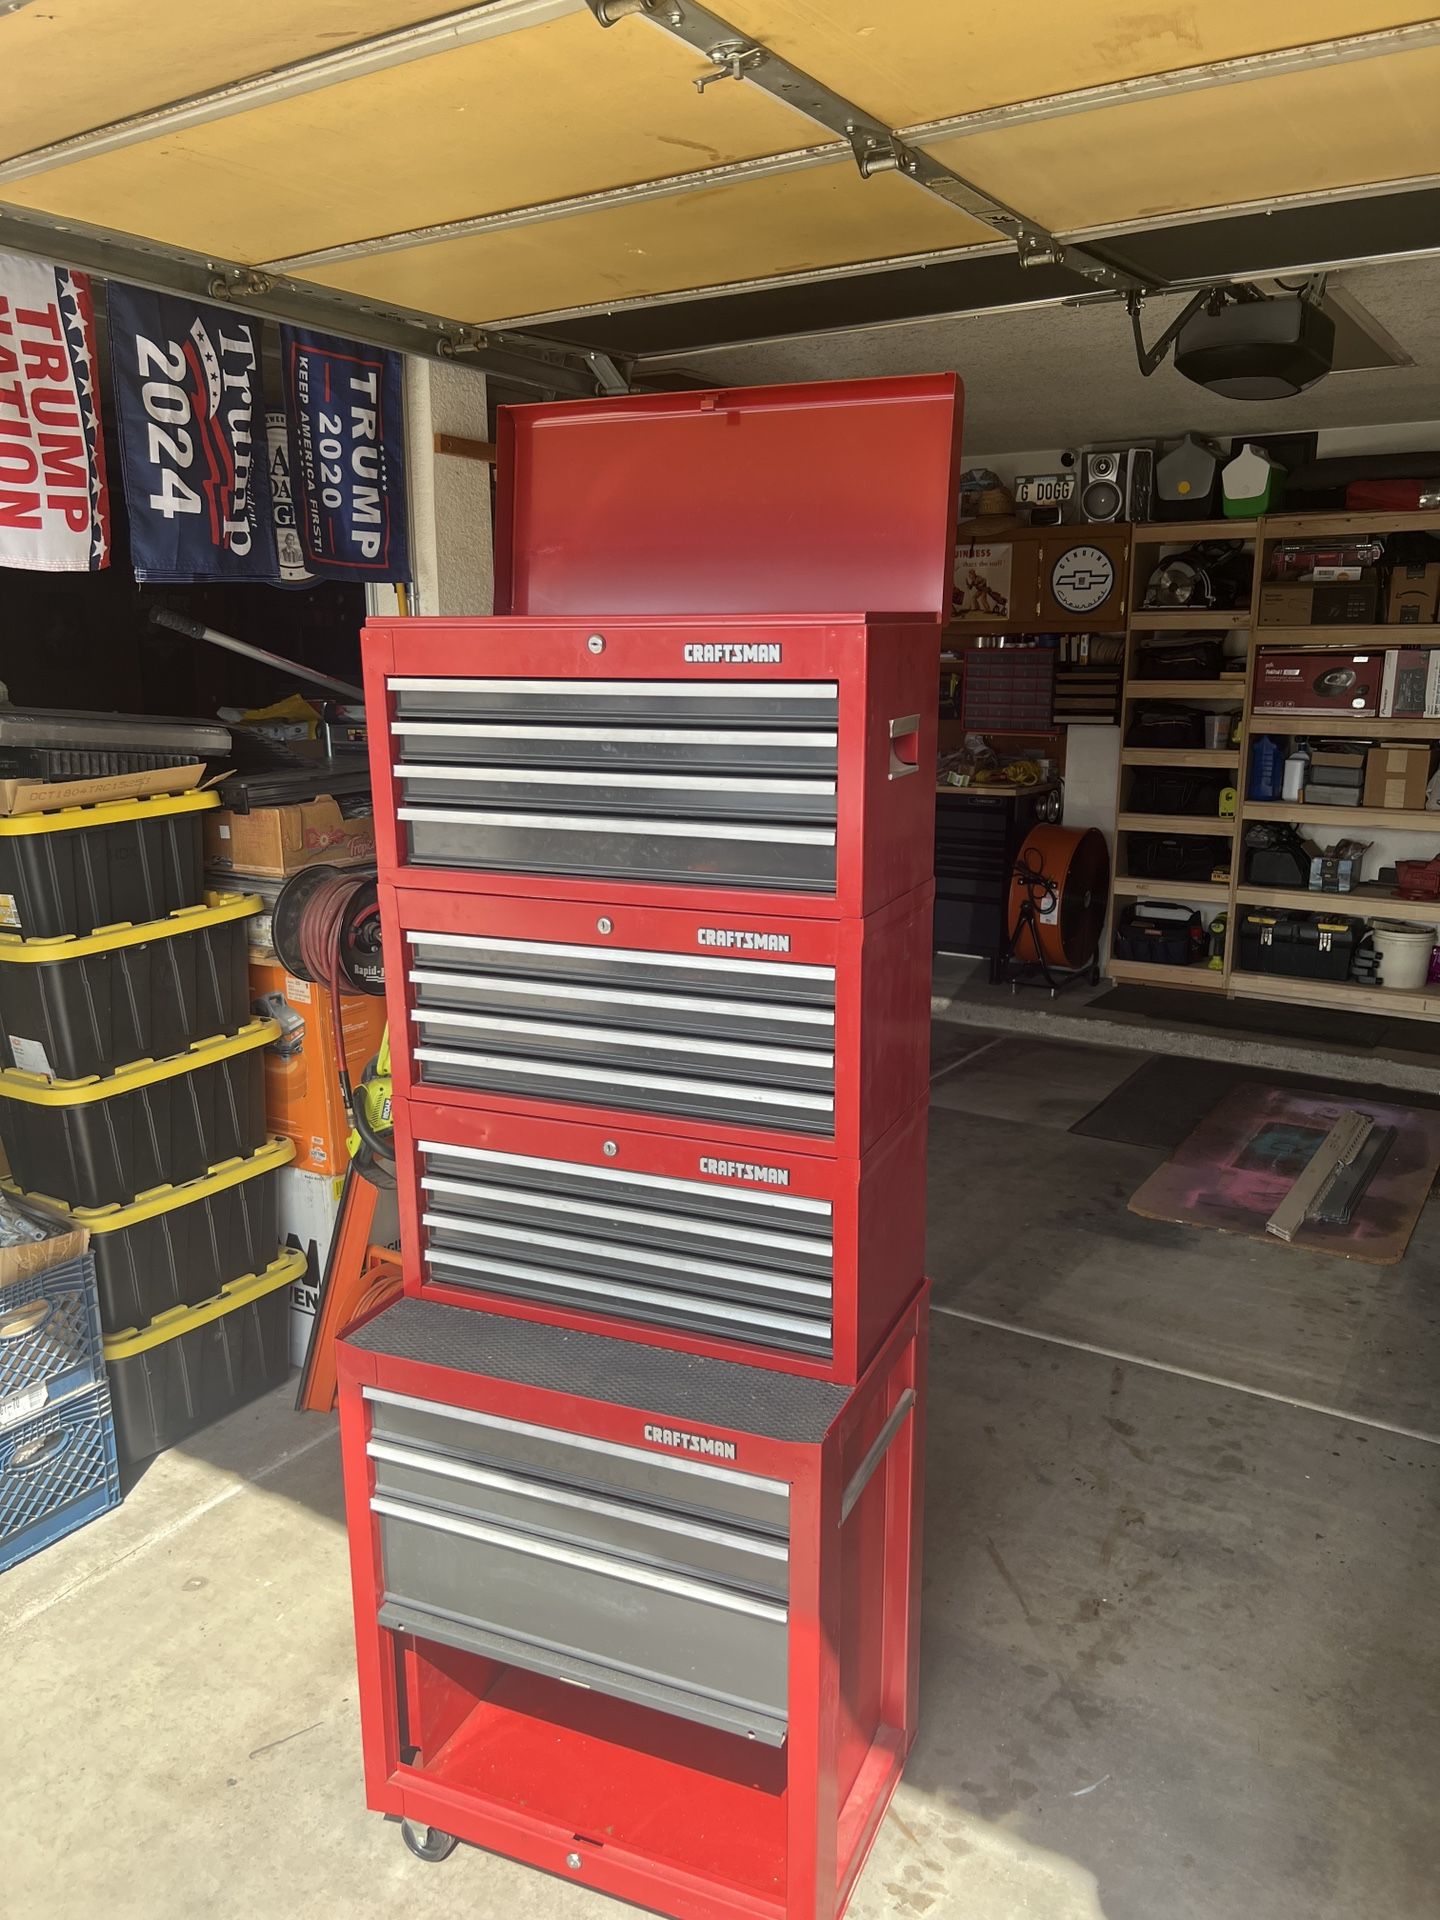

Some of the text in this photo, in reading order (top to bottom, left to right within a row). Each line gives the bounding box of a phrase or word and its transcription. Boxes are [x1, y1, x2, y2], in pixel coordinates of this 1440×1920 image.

[16, 303, 89, 533] TRUMP
[135, 333, 202, 519] 2024
[219, 324, 254, 556] Trump
[297, 356, 322, 554] KEEP AMERICA FIRST!
[318, 412, 343, 509] 2020
[350, 372, 382, 559] TRUMP
[1021, 482, 1070, 501] G DOGG
[684, 644, 781, 662] CRAFTSMAN
[697, 927, 791, 952] CRAFTSMAN
[699, 1157, 790, 1185] CRAFTSMAN
[644, 1424, 736, 1460] CRAFTSMAN
